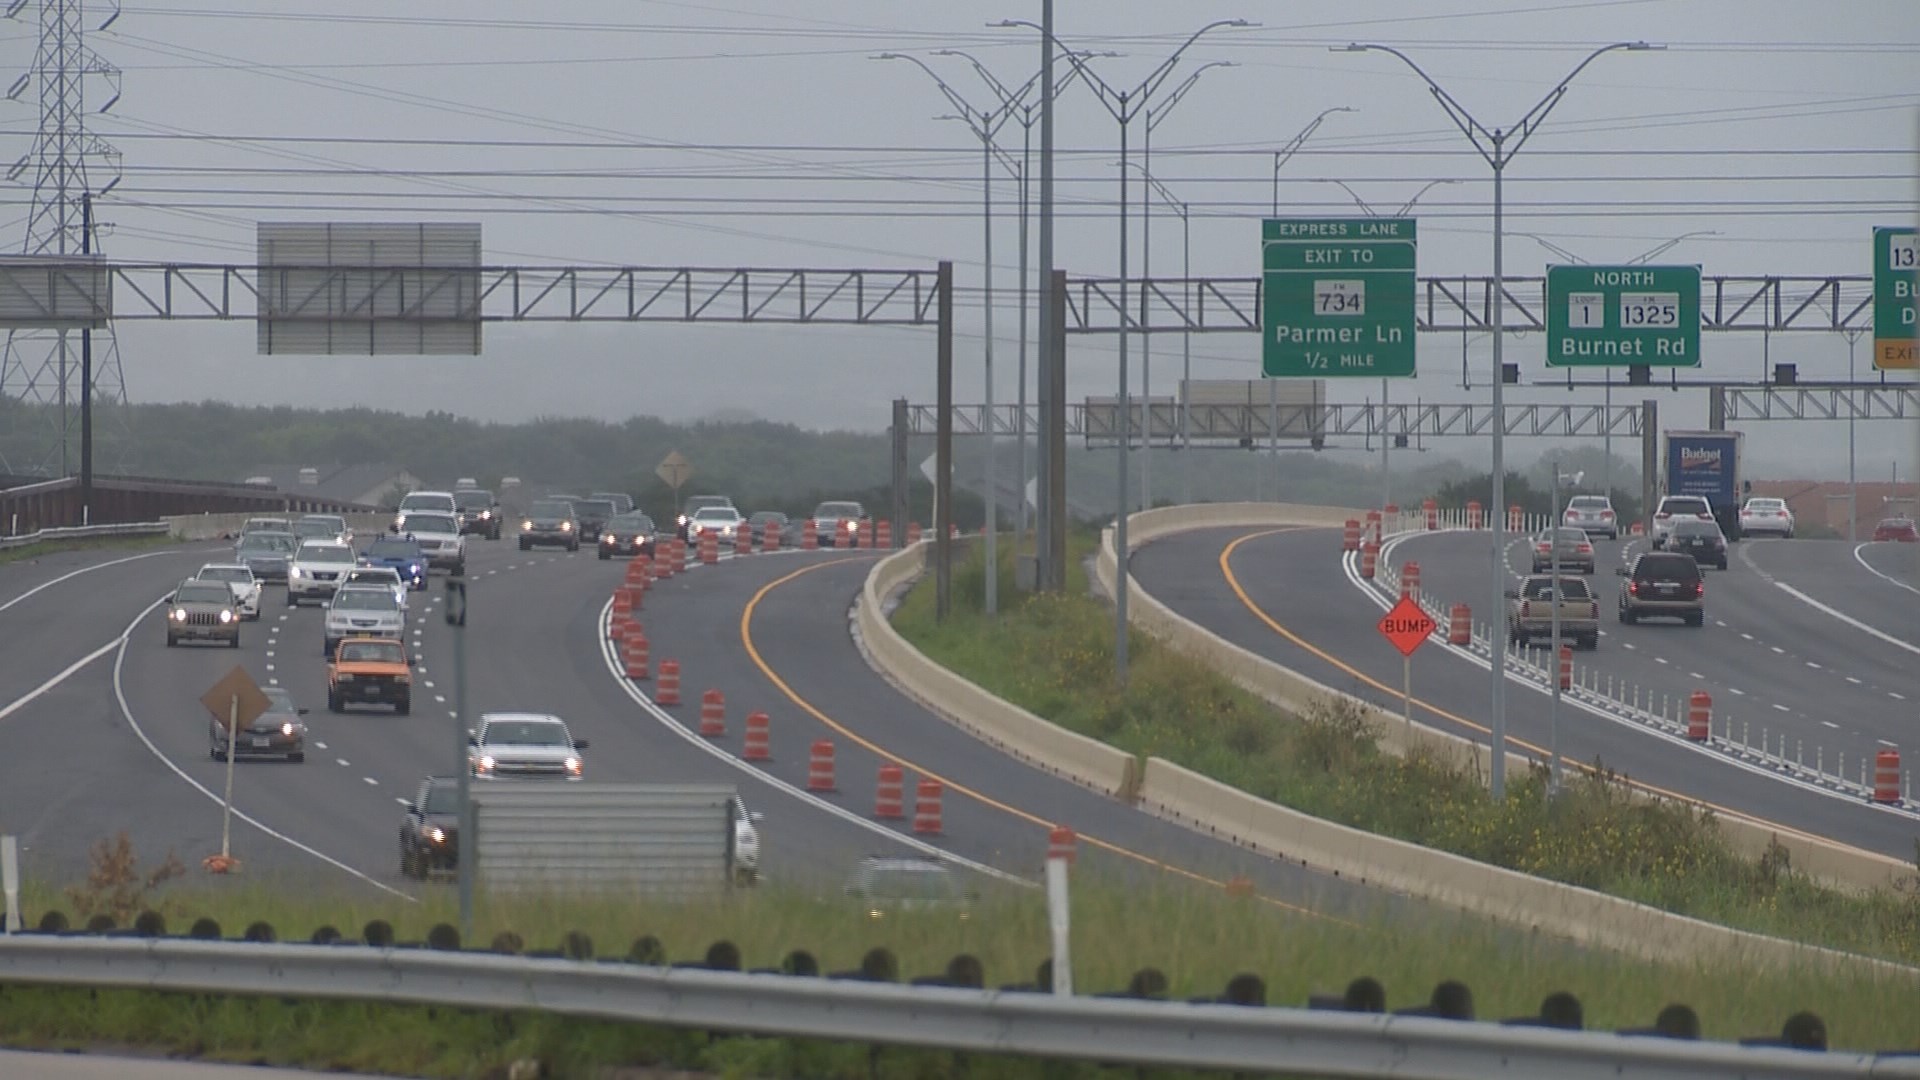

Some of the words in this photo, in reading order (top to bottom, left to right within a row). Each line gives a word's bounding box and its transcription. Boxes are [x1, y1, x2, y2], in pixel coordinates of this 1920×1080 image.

[1280, 223, 1347, 235] EXPRESS
[1360, 223, 1398, 235] LANE
[1305, 249, 1341, 263] EXIT
[1351, 249, 1374, 263] TO
[1594, 272, 1655, 286] NORTH
[1318, 293, 1360, 311] 734
[1584, 305, 1589, 325] 1
[1625, 305, 1676, 325] 1325
[1276, 325, 1363, 343] Parmer
[1376, 325, 1402, 343] Ln
[1562, 338, 1643, 356] Burnet
[1657, 337, 1686, 356] Rd
[1304, 352, 1328, 369] 1/2
[1340, 354, 1374, 366] MILE
[1681, 447, 1721, 463] Budget
[1384, 619, 1430, 633] BUMP
